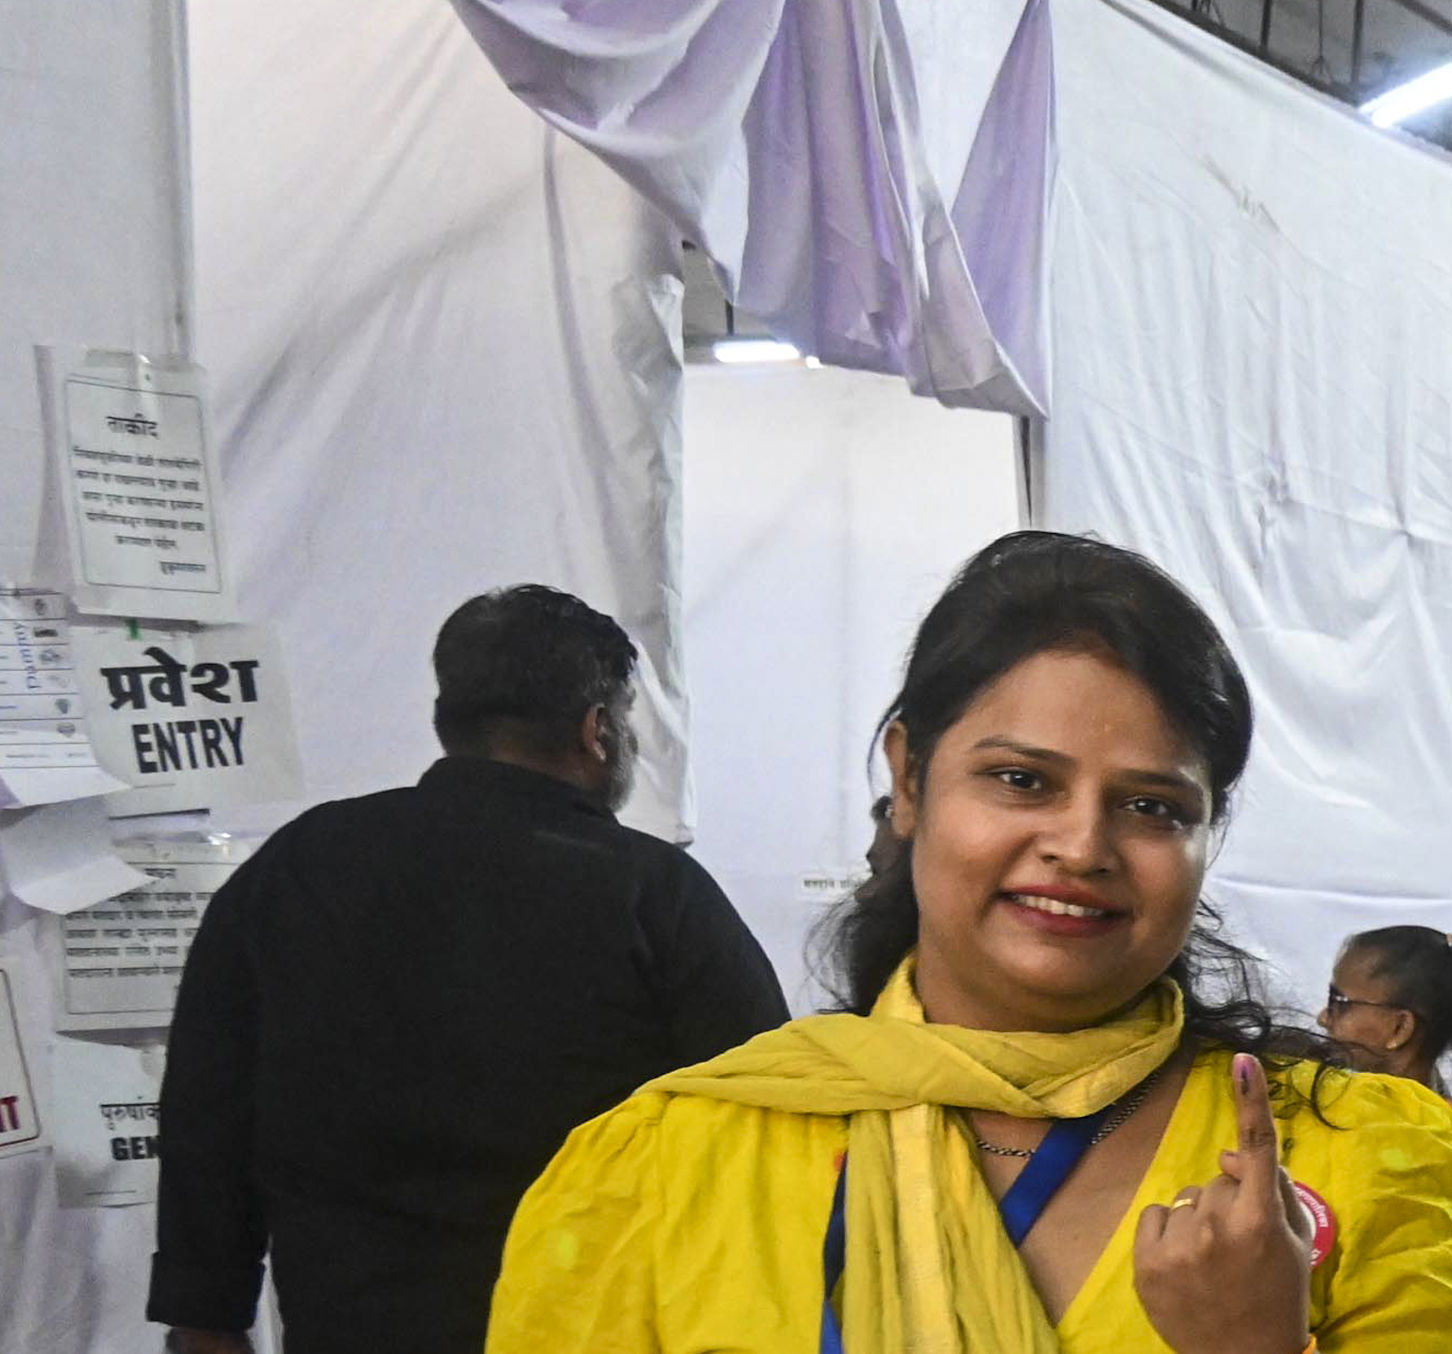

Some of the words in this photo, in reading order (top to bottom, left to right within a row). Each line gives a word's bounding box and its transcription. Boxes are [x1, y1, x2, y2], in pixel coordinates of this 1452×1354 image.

[100, 646, 259, 710] प्रवेश
[131, 717, 244, 773] ENTRY
[110, 1135, 160, 1161] GEN
